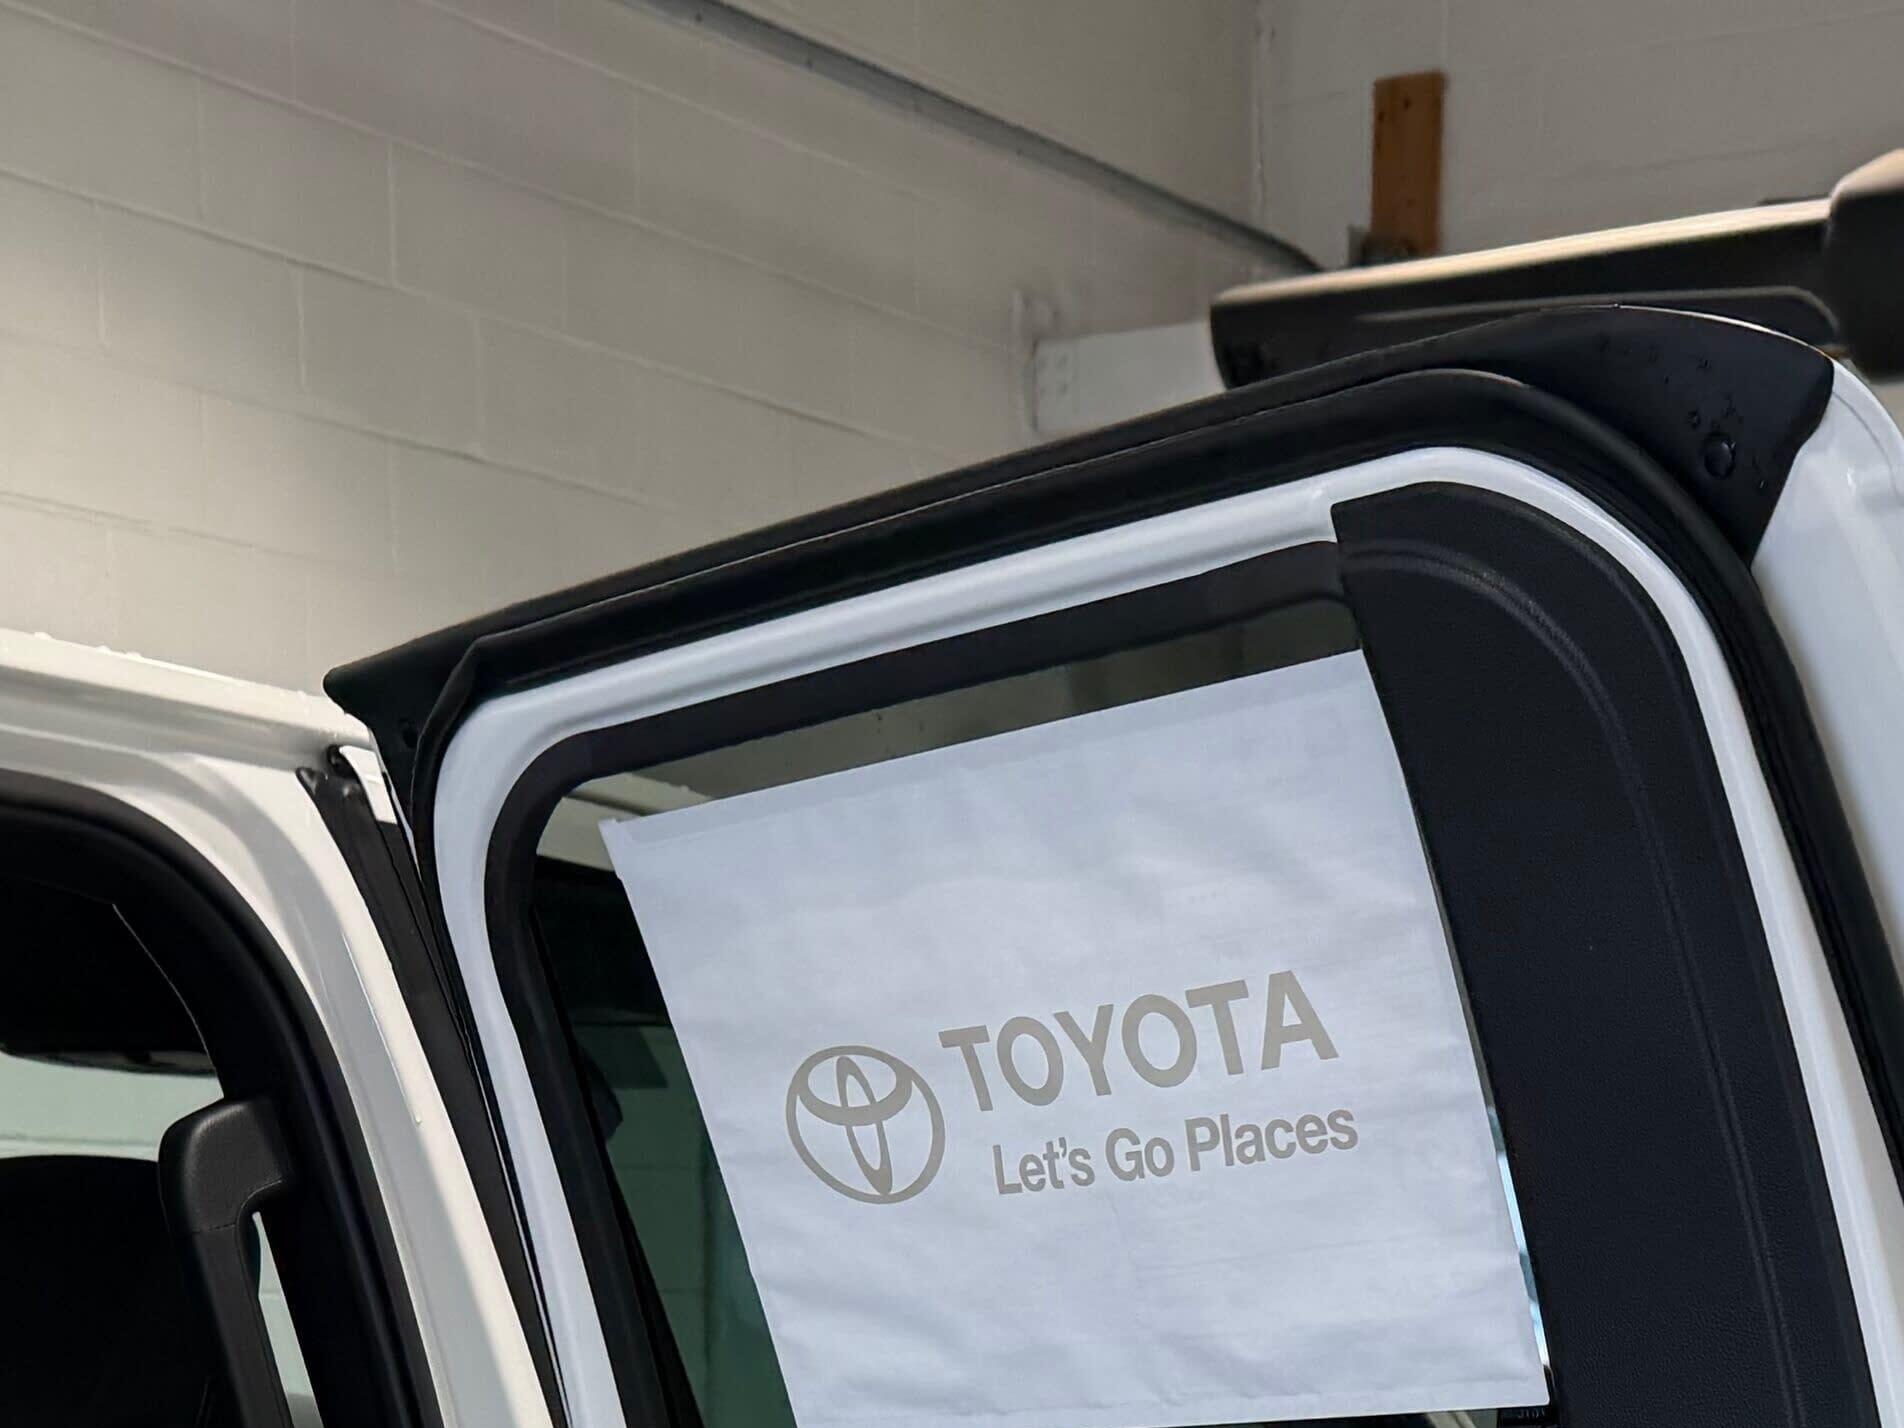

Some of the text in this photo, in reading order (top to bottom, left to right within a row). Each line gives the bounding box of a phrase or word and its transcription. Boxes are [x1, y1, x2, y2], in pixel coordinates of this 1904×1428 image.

[938, 970, 1339, 1112] TOYOTA
[992, 1108, 1358, 1195] Let's Go Places
